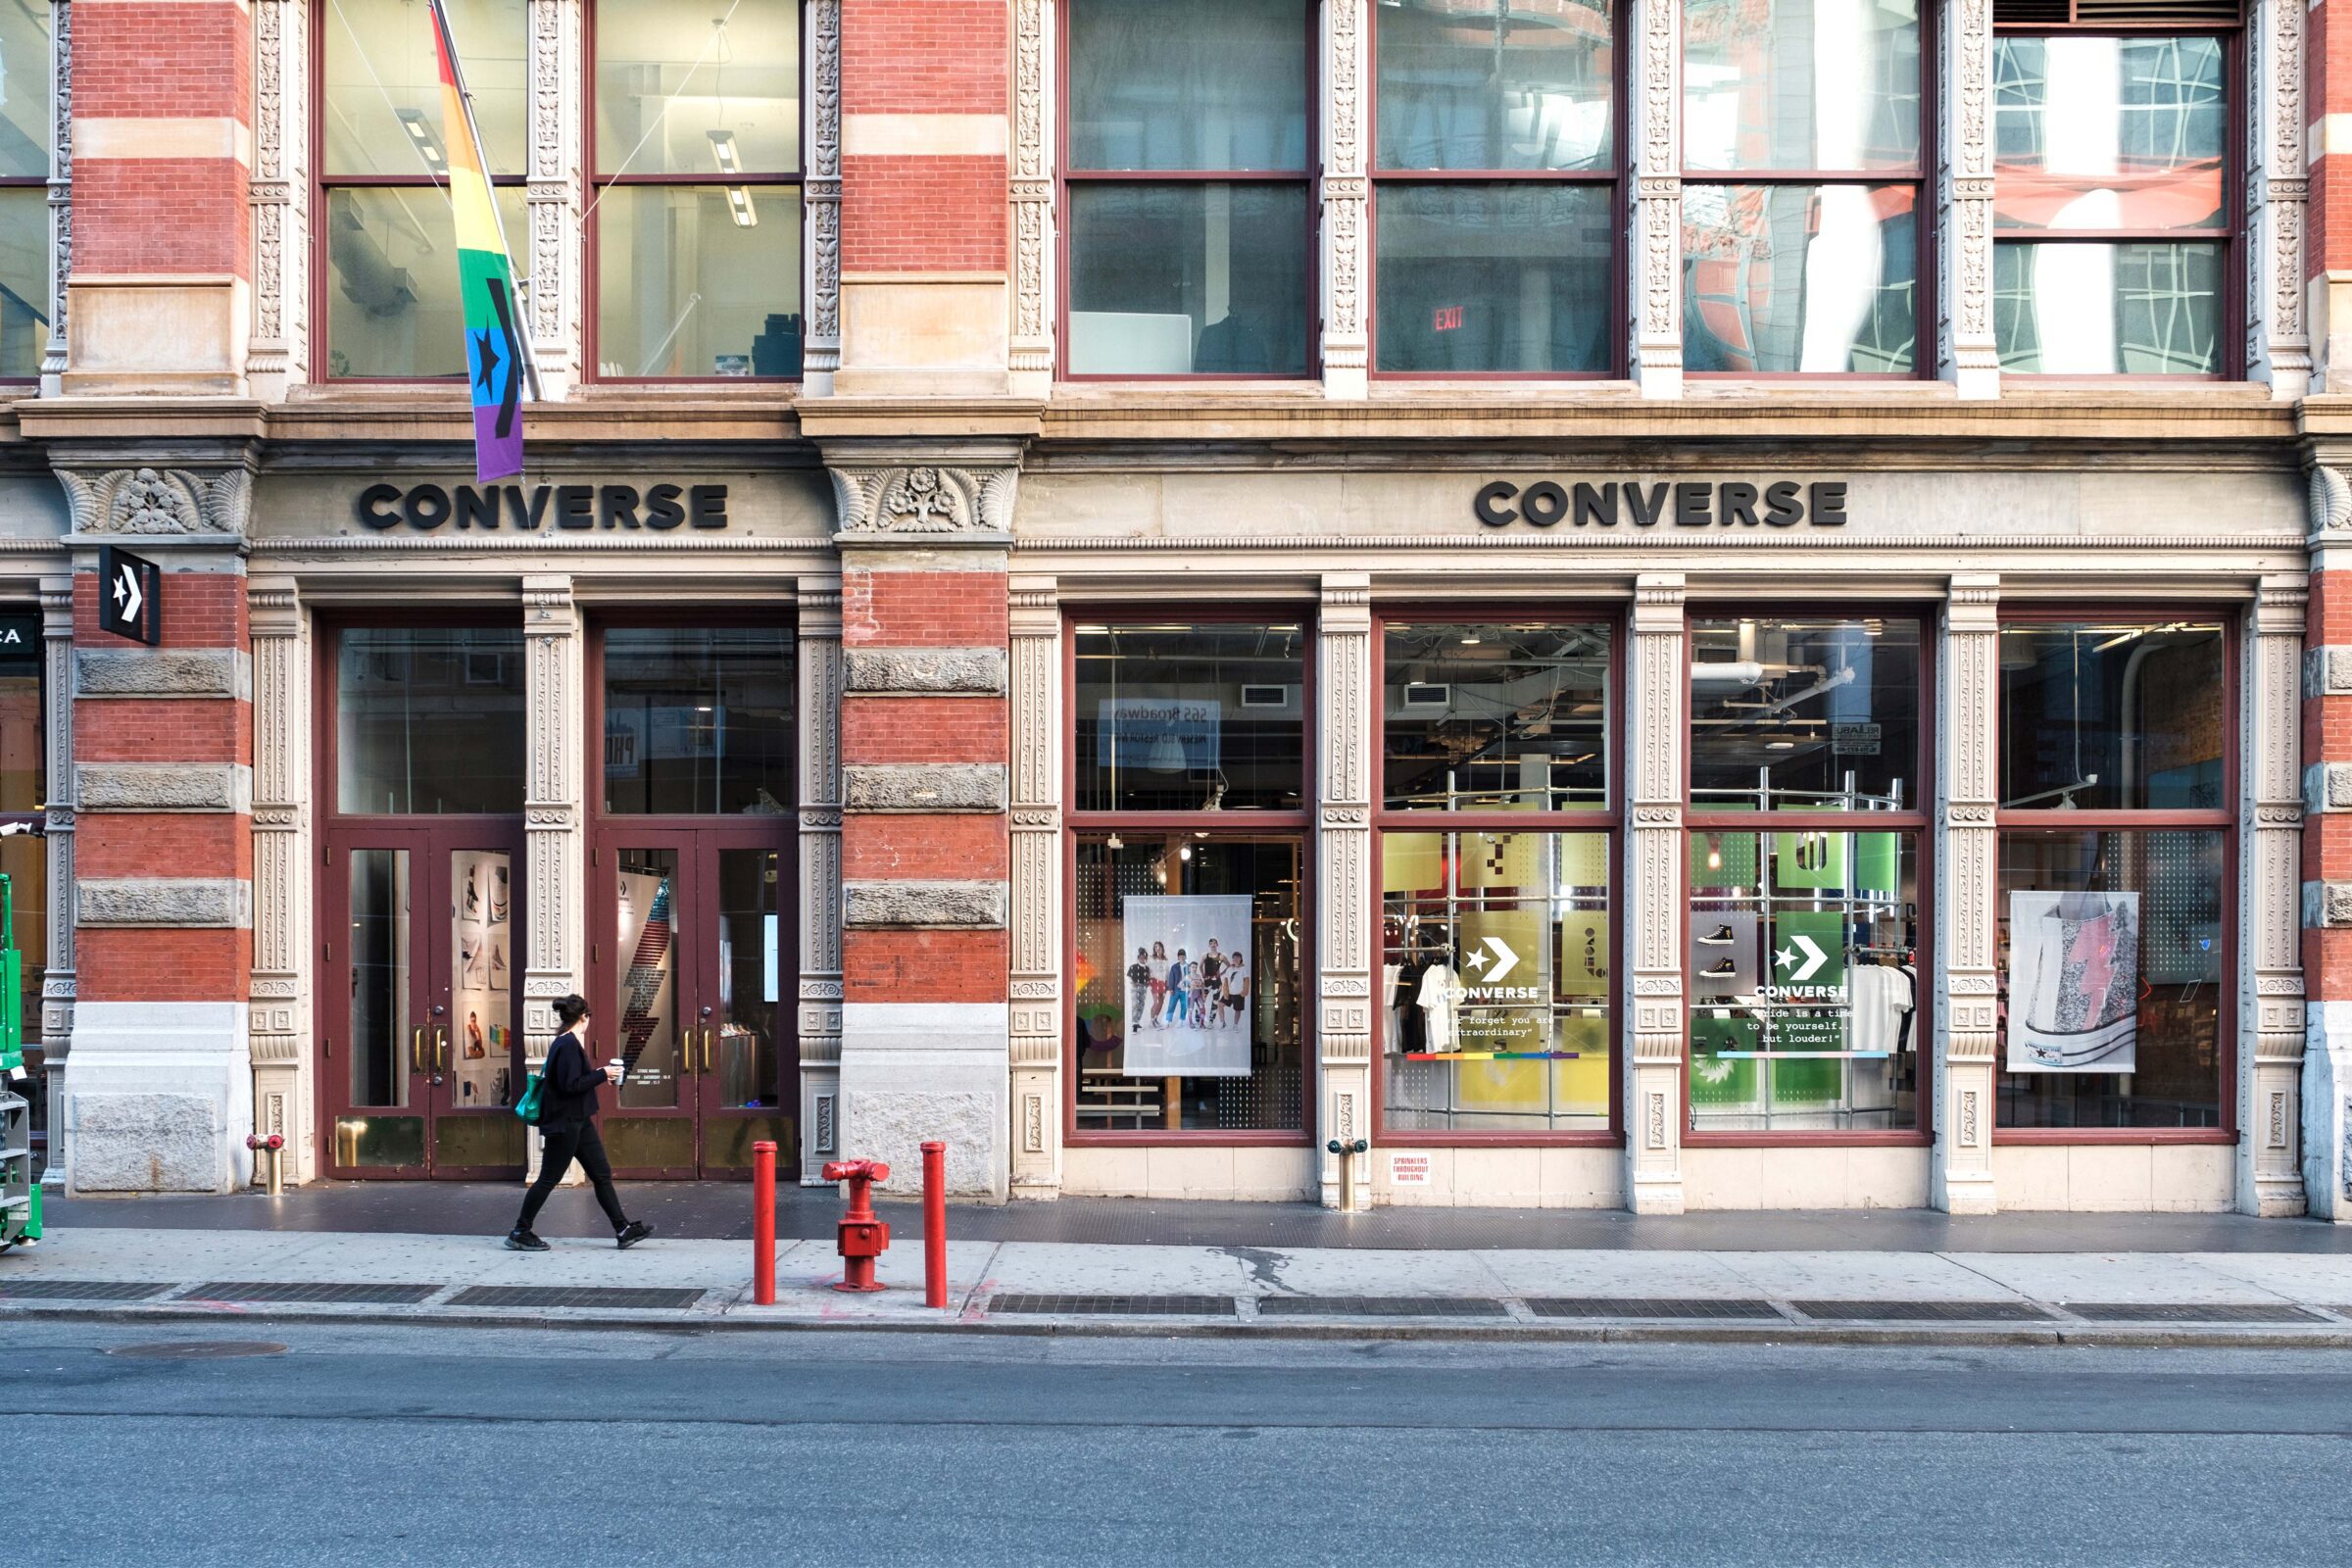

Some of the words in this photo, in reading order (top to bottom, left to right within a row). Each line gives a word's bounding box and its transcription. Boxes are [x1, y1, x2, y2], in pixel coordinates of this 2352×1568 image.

[1436, 306, 1463, 330] EXIT
[359, 483, 728, 529] CONVERSE
[1475, 481, 1847, 526] CONVERSE
[0, 629, 22, 643] A
[1754, 986, 1848, 998] CONVERSE
[1758, 1008, 1789, 1018] ride
[1796, 1009, 1809, 1018] is
[1828, 1009, 1854, 1018] time
[1470, 1016, 1506, 1026] forget
[1511, 1017, 1530, 1026] you
